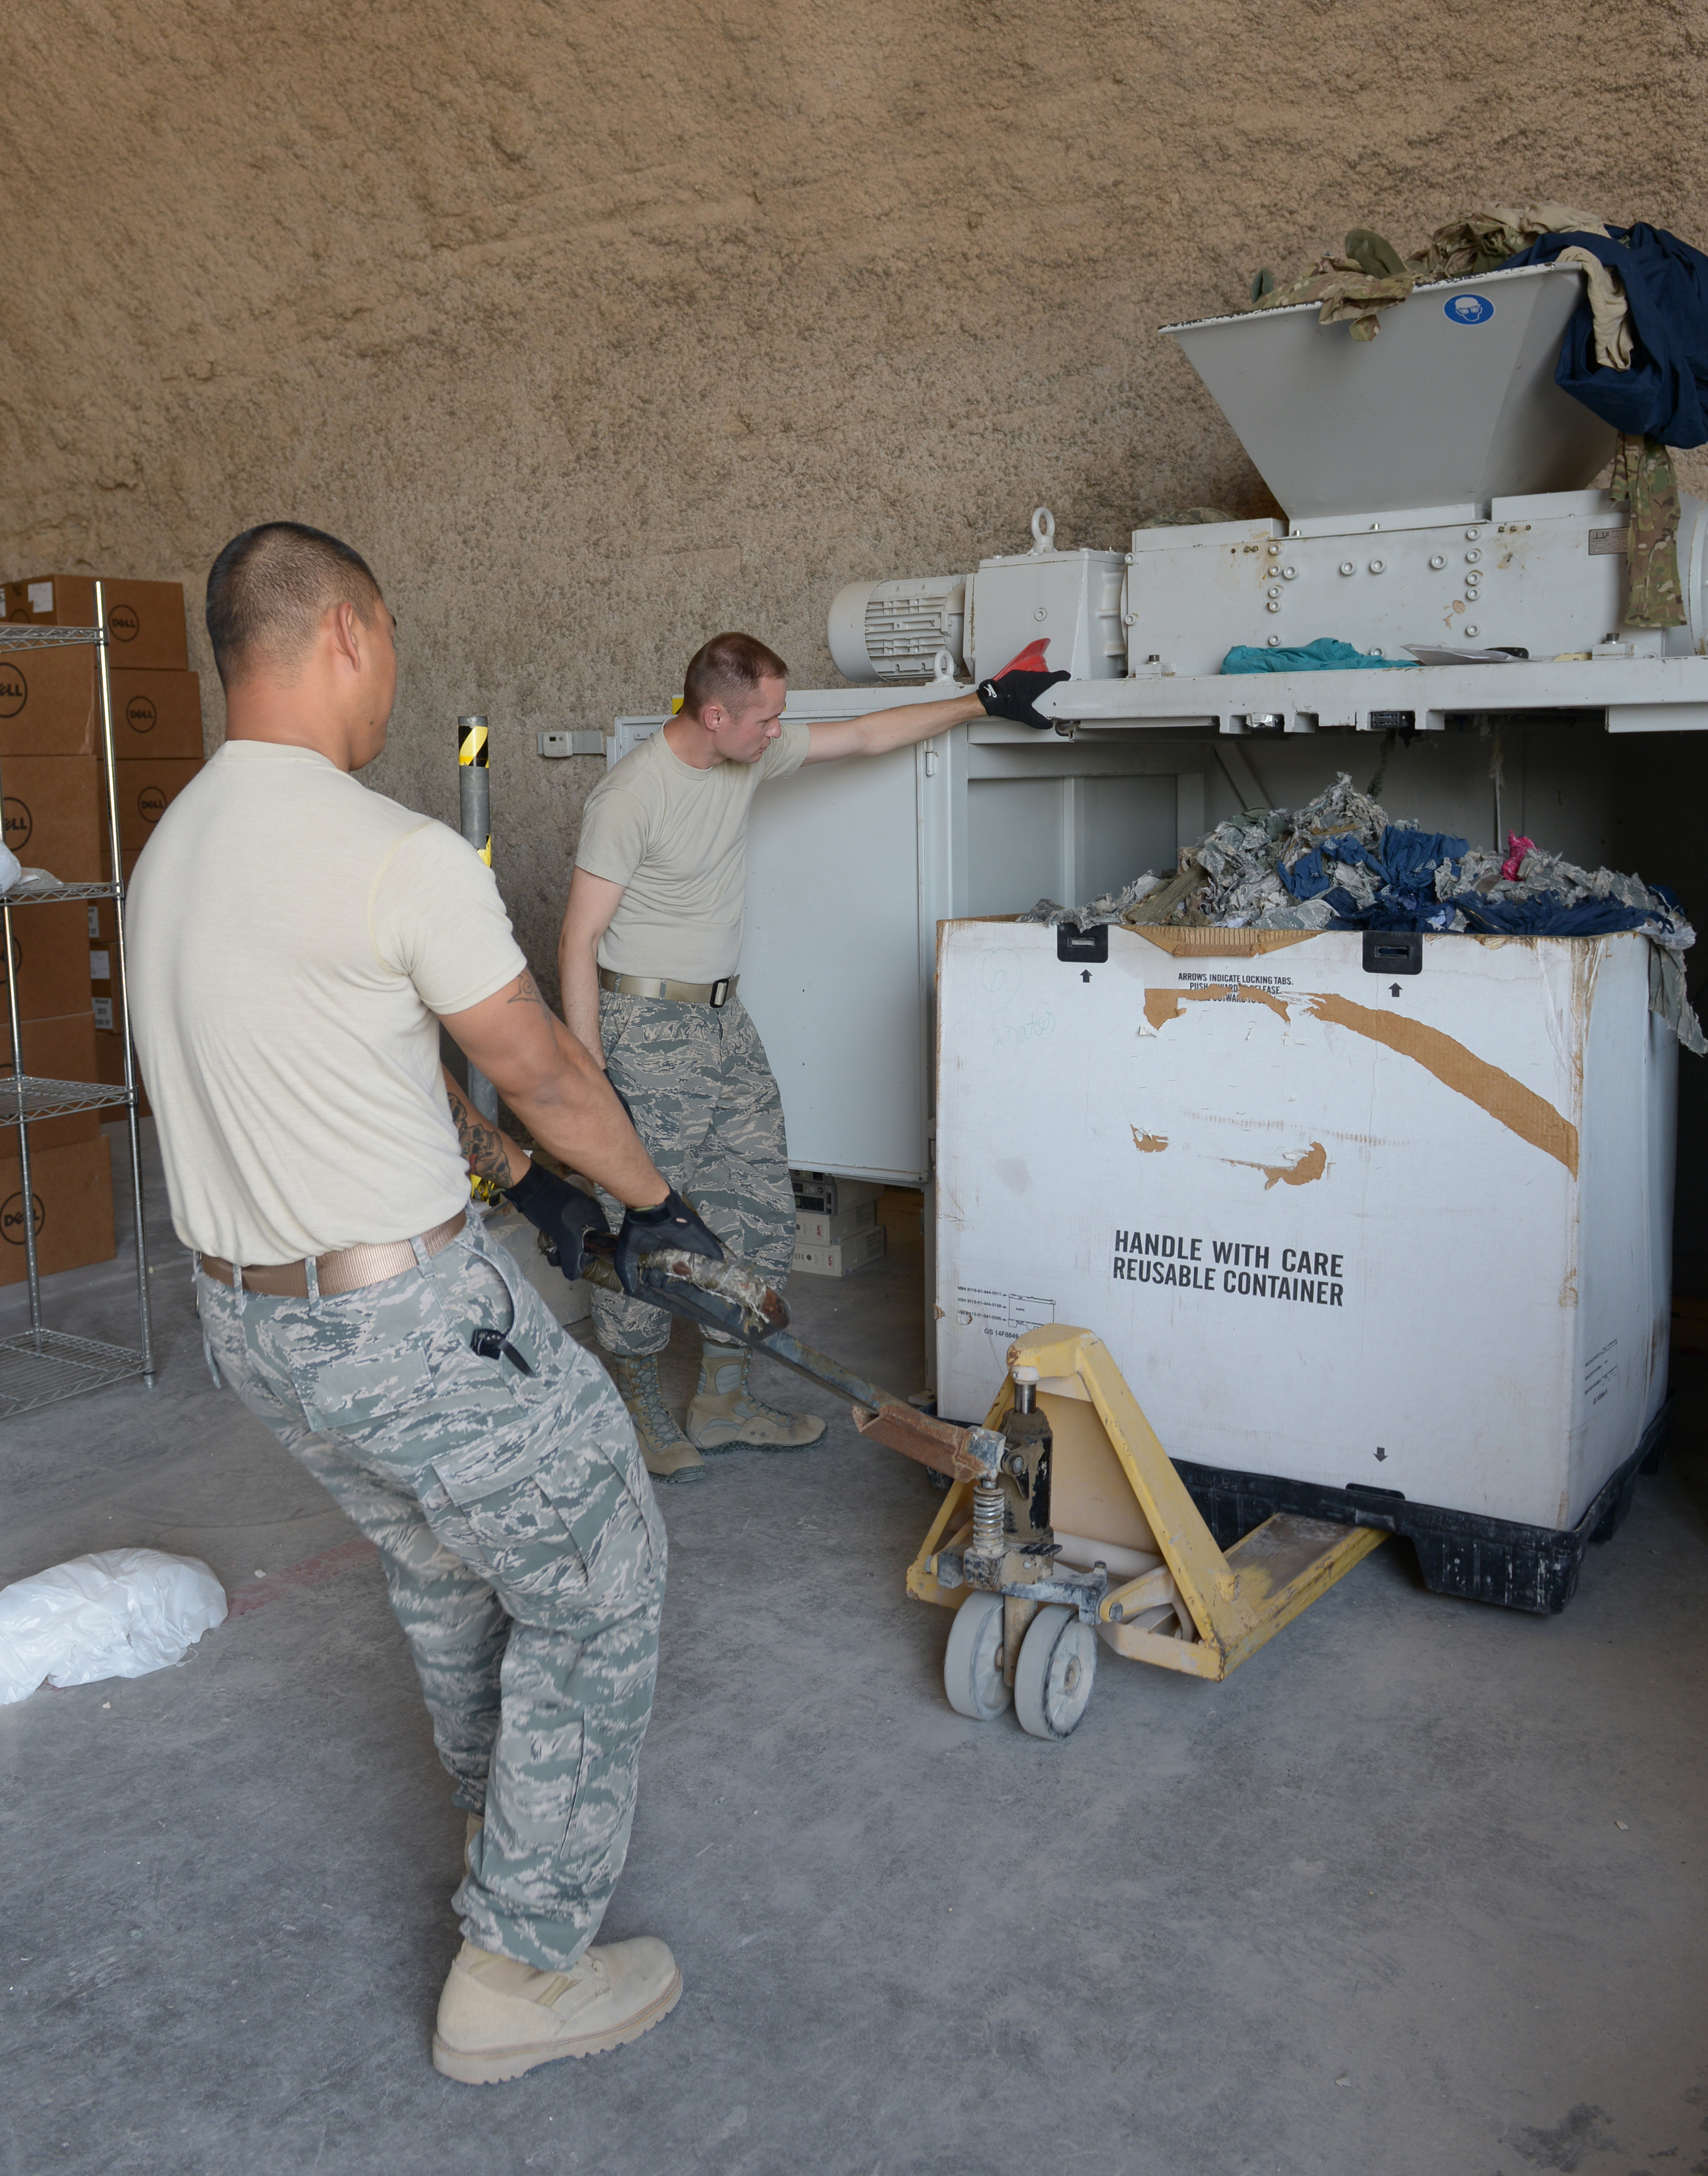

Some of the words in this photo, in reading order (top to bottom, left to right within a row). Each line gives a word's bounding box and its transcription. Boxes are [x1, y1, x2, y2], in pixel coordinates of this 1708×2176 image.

[112, 618, 135, 628] DELL
[0, 683, 22, 696] ELL
[130, 710, 153, 719] DELL
[142, 800, 164, 809] DELL
[5, 817, 27, 831] ELL
[1178, 973, 1207, 981] ARROWS
[1209, 974, 1241, 983] INDICATE
[1242, 975, 1273, 984] LOCKING
[1274, 976, 1294, 985] TABS.
[4, 1210, 40, 1227] DEL
[1115, 1230, 1202, 1261] HANDLE
[1212, 1240, 1269, 1269] WITH
[1282, 1248, 1344, 1278] CARE
[1113, 1257, 1216, 1290] REUSABLE
[1223, 1270, 1343, 1306] CONTAINER
